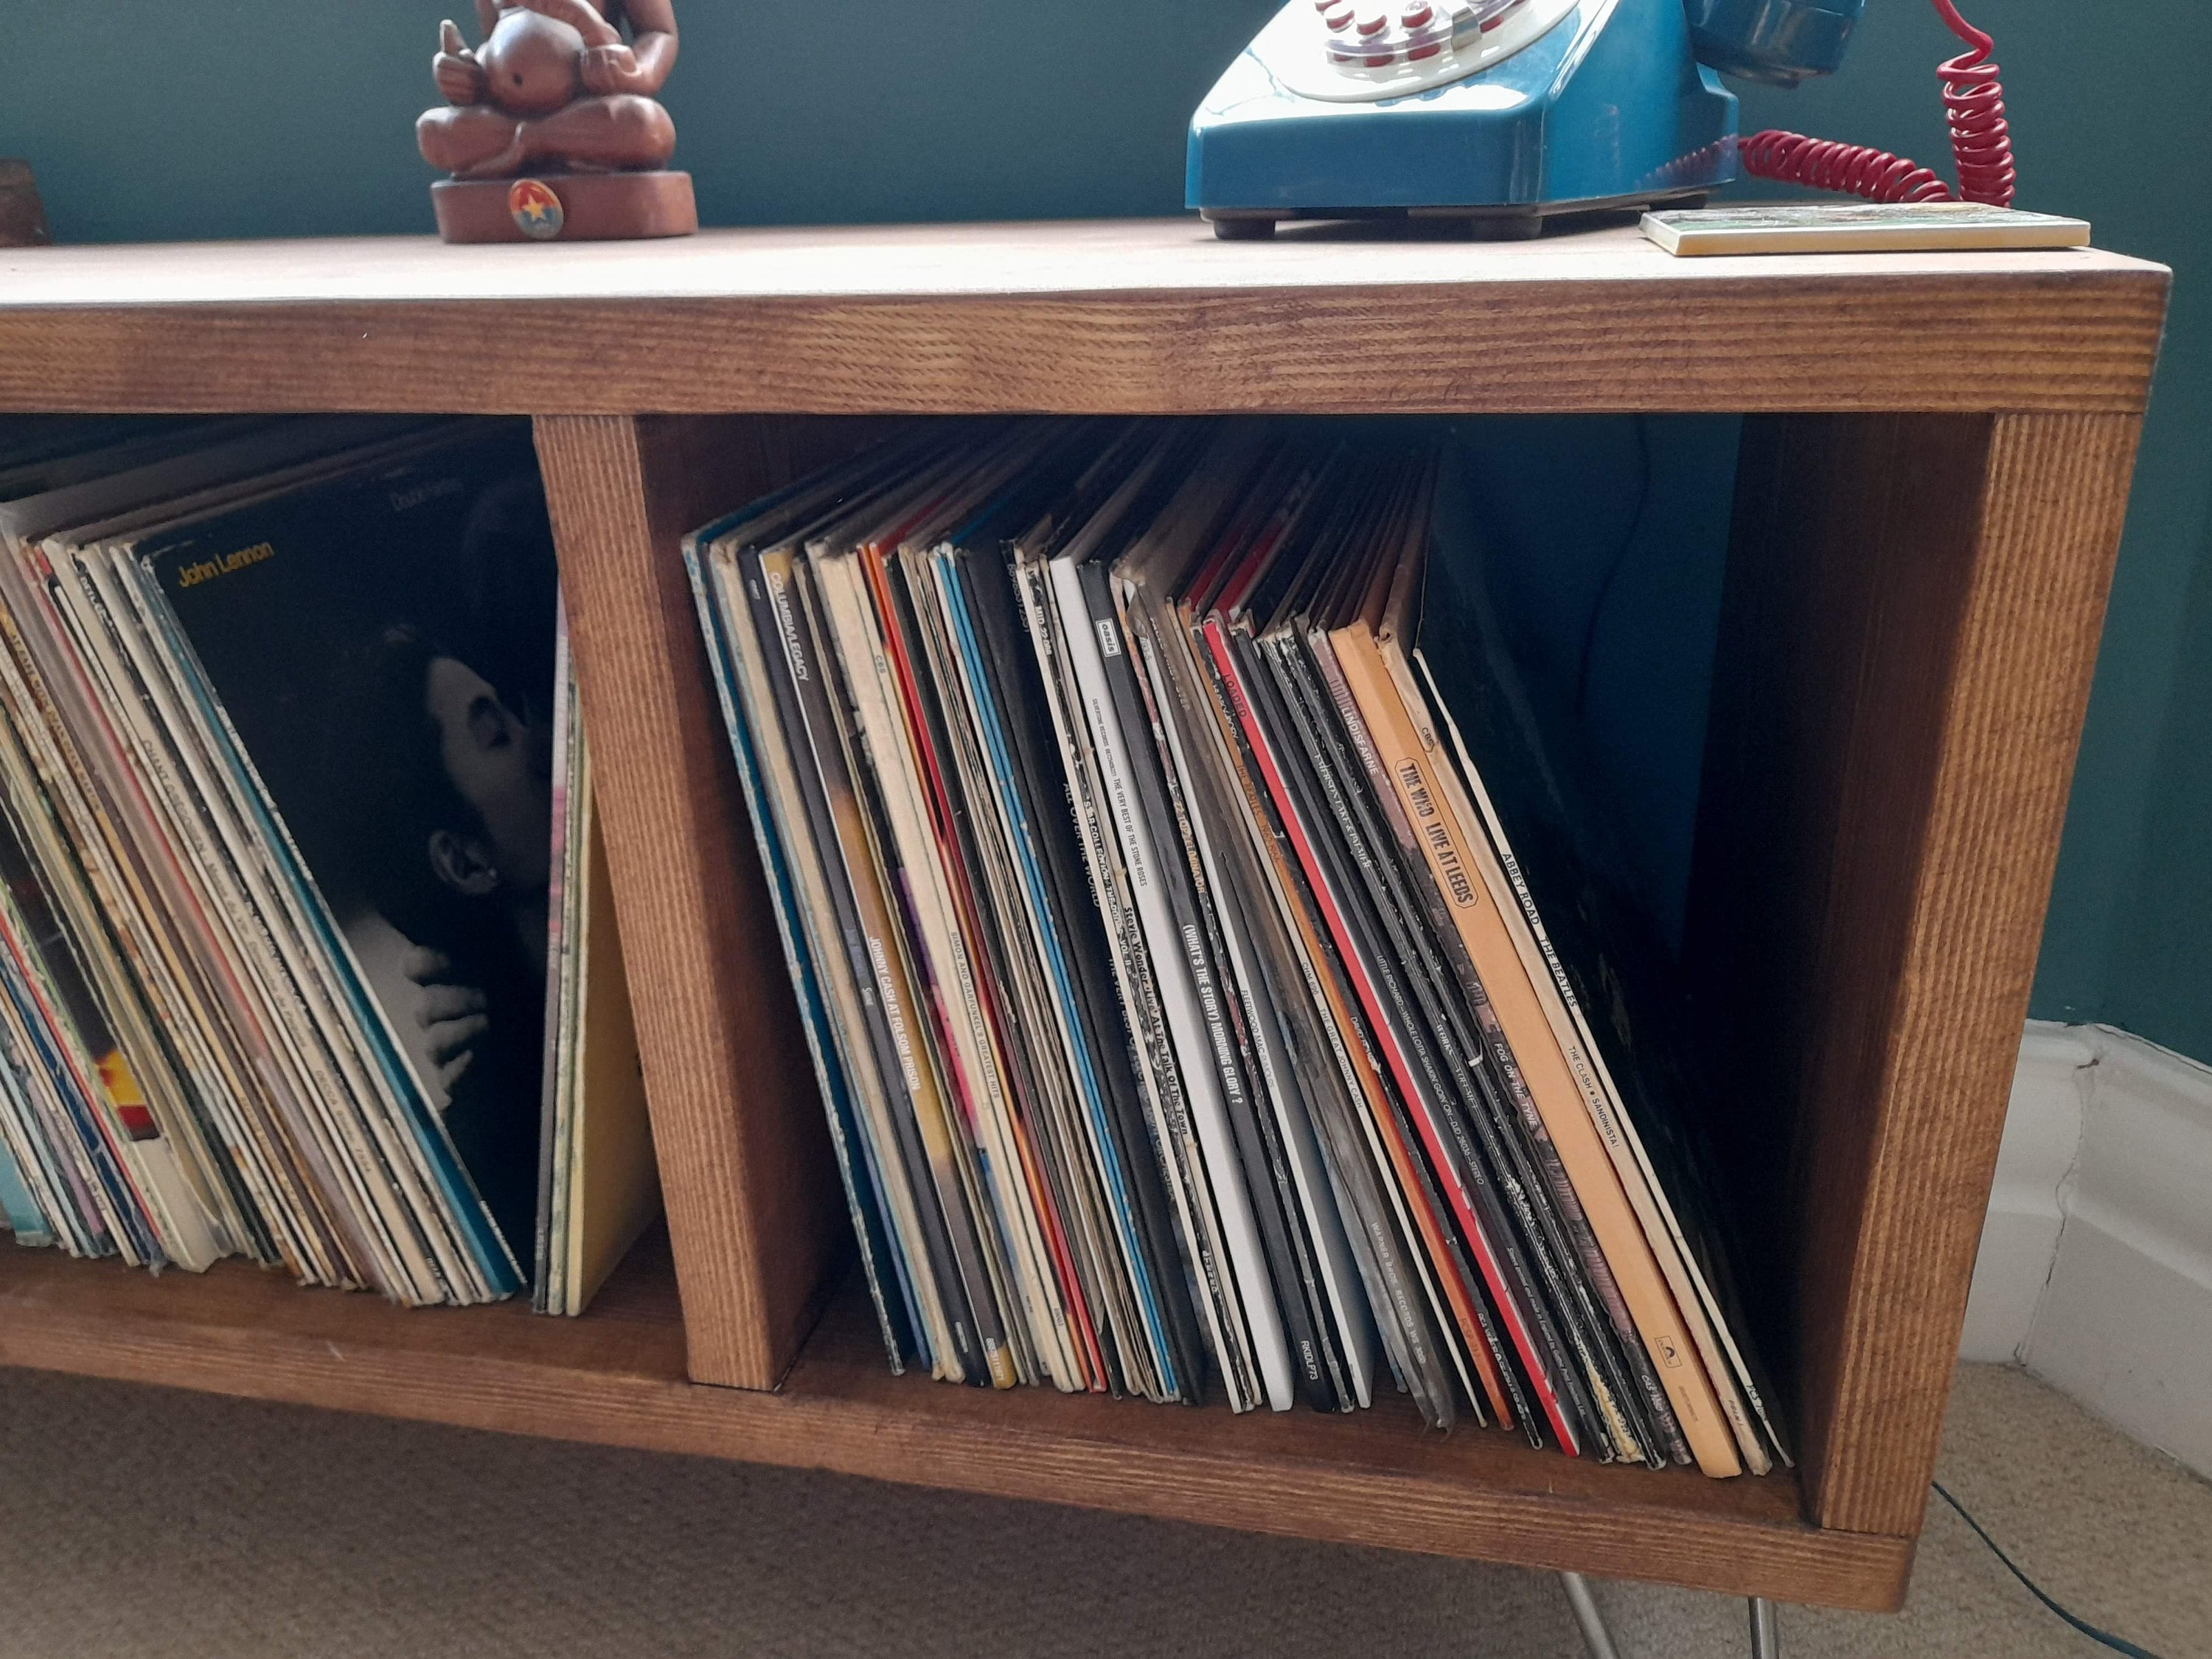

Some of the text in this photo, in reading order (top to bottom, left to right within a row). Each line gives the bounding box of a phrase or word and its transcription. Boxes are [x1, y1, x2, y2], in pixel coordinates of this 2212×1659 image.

[179, 542, 275, 589] John Lennon
[769, 570, 809, 683] COLUMBIA/LEGACY
[1100, 622, 1116, 653] oasis
[1221, 671, 1248, 718] LOADED
[1340, 706, 1380, 776] LINDISFARNE
[1420, 726, 1435, 747] CBS
[1062, 782, 1074, 804] ALL
[1068, 806, 1083, 840] OVER
[1236, 762, 1248, 781] THE
[1243, 782, 1262, 816] BEATLES
[1312, 753, 1339, 799] EMERSON
[1349, 831, 1371, 869] PALMER
[1113, 778, 1147, 887] THE VERY BEST OF THE STONE ROSES
[1399, 762, 1473, 905] THE WHO LIVE AT LEEDS
[1123, 905, 1139, 939] Stevie
[1182, 923, 1203, 967] (WHAT'S
[1501, 850, 1578, 1009] ABBEY ROAD THE BEATLES
[1133, 942, 1151, 985] Wonder
[1194, 967, 1208, 986] THE
[1301, 961, 1313, 981] CHM
[869, 934, 922, 1091] JOHNNY CASH AT FOLSOM PRISON
[950, 931, 1000, 1099] SIMON AND GARFUNKEL'S GREATEST HITS
[1152, 1015, 1163, 1030] At
[1200, 985, 1219, 1022] STORY)
[1239, 988, 1259, 1034] FLEETWOOD
[1253, 1033, 1265, 1055] MAC
[1376, 954, 1389, 975] LITTLE
[1412, 1034, 1426, 1056] LOTTA
[1155, 1031, 1167, 1049] The
[1161, 1051, 1174, 1074] Talk
[1210, 1020, 1231, 1065] MORNING
[1319, 1007, 1364, 1110] THE GREAT JOHNNY CASH
[1434, 1023, 1455, 1057] WORKS
[1167, 1074, 1177, 1085] Of
[1170, 1088, 1182, 1106] The
[1222, 1065, 1240, 1098] GLORY
[1492, 1040, 1538, 1128] FOG ON THE TYNE
[1567, 1045, 1620, 1150] THE CLASH SANDINISTA!
[1175, 1108, 1190, 1135] Town
[1370, 1221, 1389, 1259] WARNER
[1394, 1287, 1414, 1329] RECORDS
[1299, 1338, 1320, 1382] RKIDLP73
